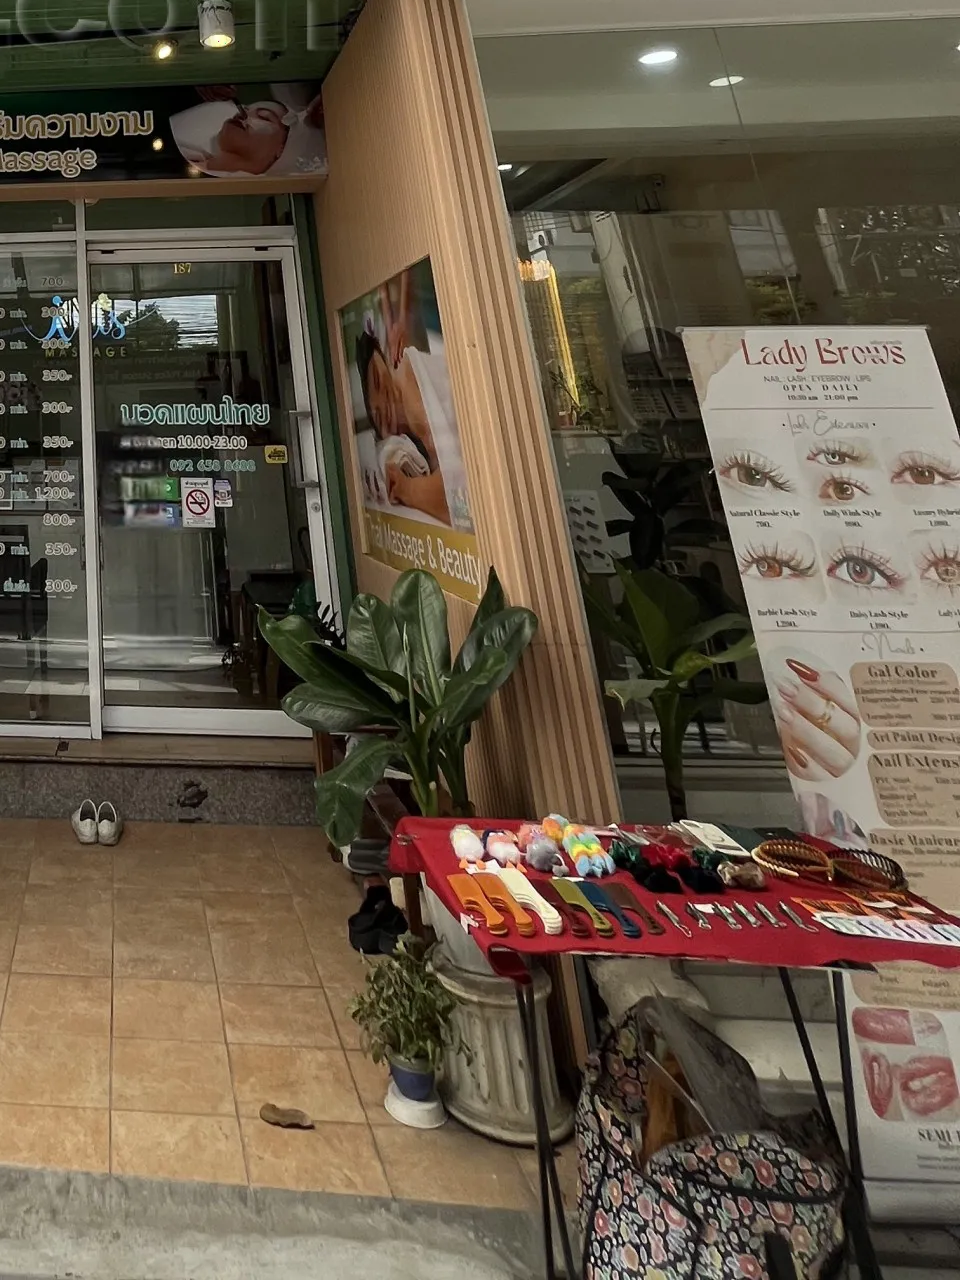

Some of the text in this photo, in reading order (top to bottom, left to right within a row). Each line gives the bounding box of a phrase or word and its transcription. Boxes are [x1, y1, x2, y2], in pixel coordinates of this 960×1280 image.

[173, 263, 191, 274] 187
[45, 347, 127, 357] MASAGE
[740, 337, 907, 373] Lady Brows
[782, 384, 860, 392] OPEN DAILY
[121, 395, 270, 426] นวดแผนไทย
[178, 435, 247, 450] 10.00-23.00
[384, 523, 426, 569] Massage
[426, 534, 438, 569] &
[437, 537, 482, 601] Beauty
[894, 665, 939, 679] Color
[872, 753, 902, 768] Nail
